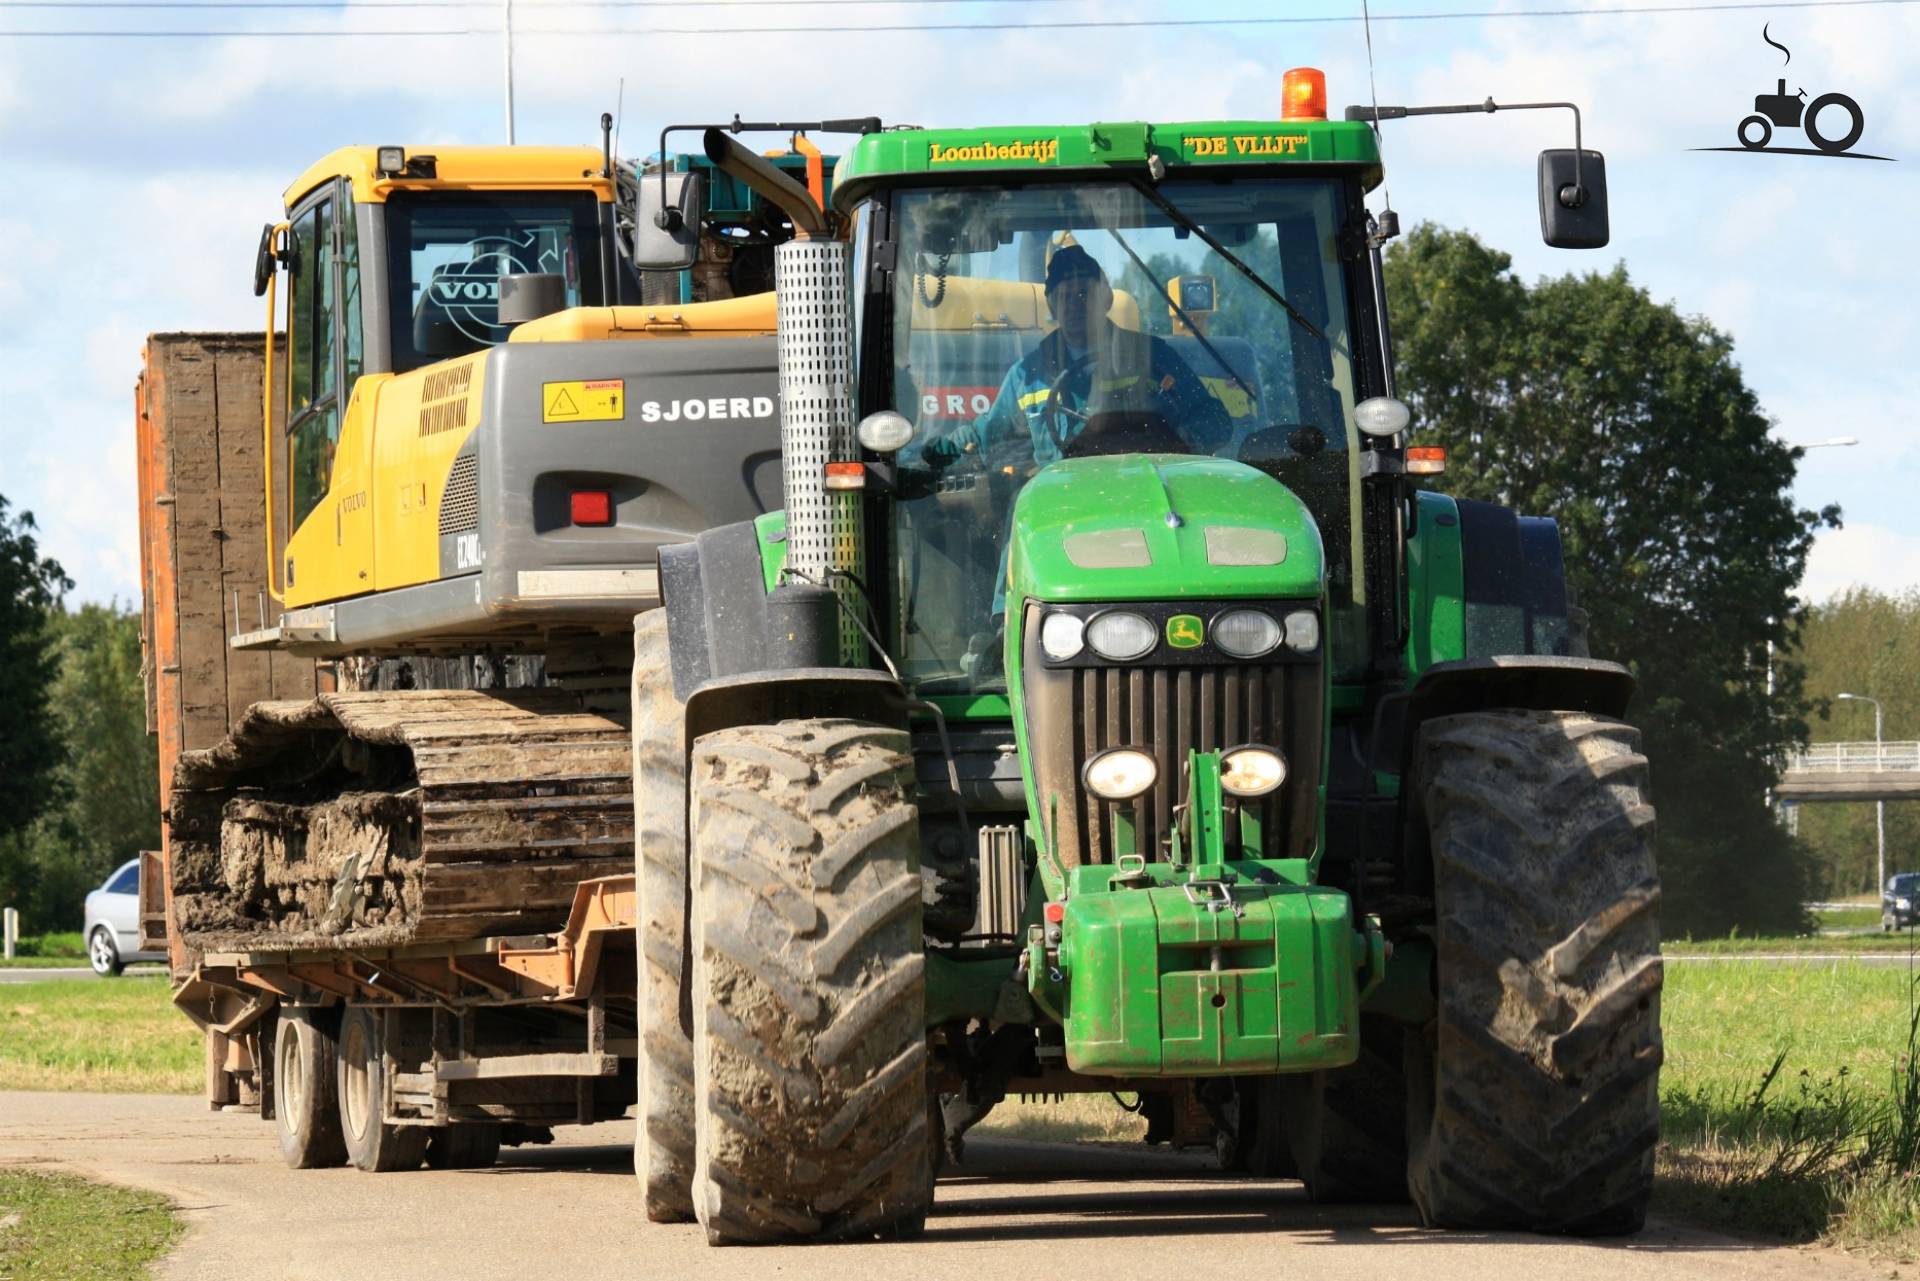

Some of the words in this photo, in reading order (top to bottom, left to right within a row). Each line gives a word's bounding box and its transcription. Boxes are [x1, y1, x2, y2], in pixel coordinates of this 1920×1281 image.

[929, 140, 1057, 163] Loonbedrijf
[641, 397, 774, 423] SJOERD
[342, 490, 367, 514] VOLVO
